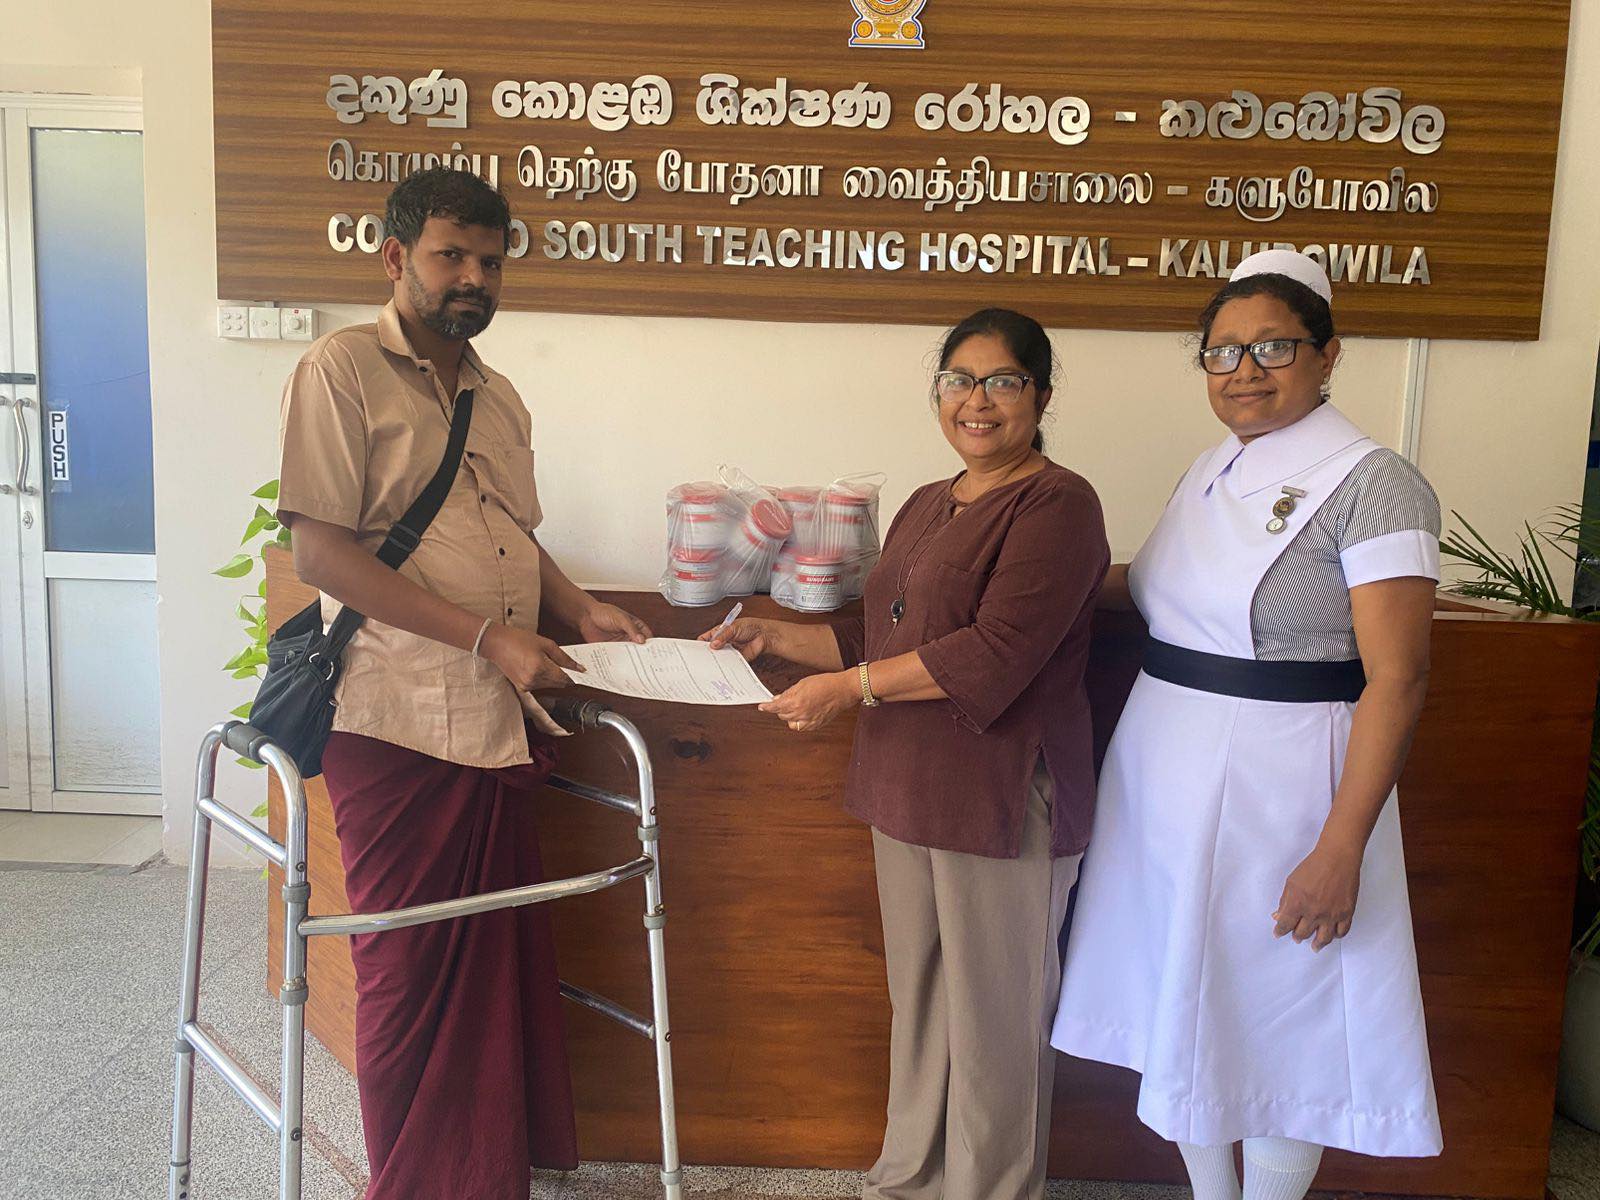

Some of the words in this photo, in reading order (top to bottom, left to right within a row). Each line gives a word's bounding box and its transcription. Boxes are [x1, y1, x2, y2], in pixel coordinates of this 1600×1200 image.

[326, 69, 468, 128] දකුණු
[491, 75, 673, 131] කොළඹ
[696, 73, 891, 128] ශික්ෂණ
[914, 83, 1091, 146] රෝහල
[517, 144, 638, 202] தெற்கு
[657, 149, 824, 205] போதனா
[843, 155, 1153, 212] வைத்தியசாலை
[1205, 165, 1439, 222] களுபோவில
[543, 219, 683, 264] SOUTH
[697, 225, 905, 271] TEACHING
[920, 232, 1120, 276] HOSPITAL
[1158, 238, 1431, 285] KALOWILA
[51, 412, 67, 478] PUSH
